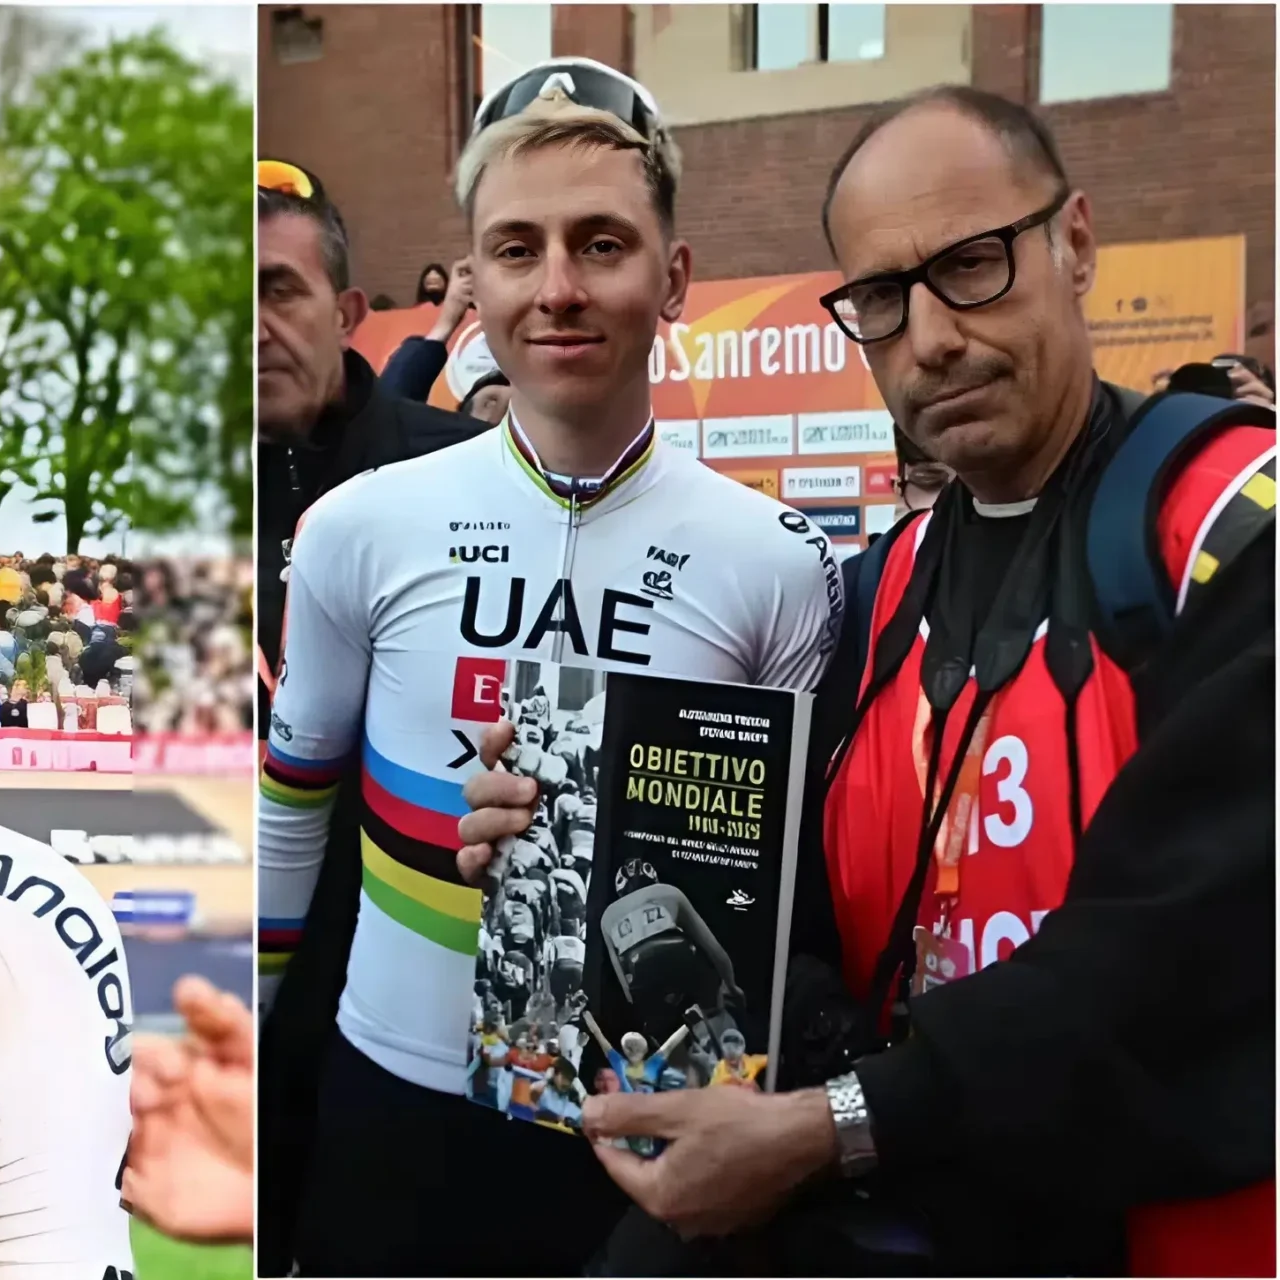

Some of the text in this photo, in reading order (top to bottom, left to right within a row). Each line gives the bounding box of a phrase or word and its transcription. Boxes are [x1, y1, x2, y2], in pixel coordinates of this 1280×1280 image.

[459, 576, 655, 666] UAE
[629, 743, 765, 785] OBIETTIVO
[626, 776, 764, 819] MONDIALE
